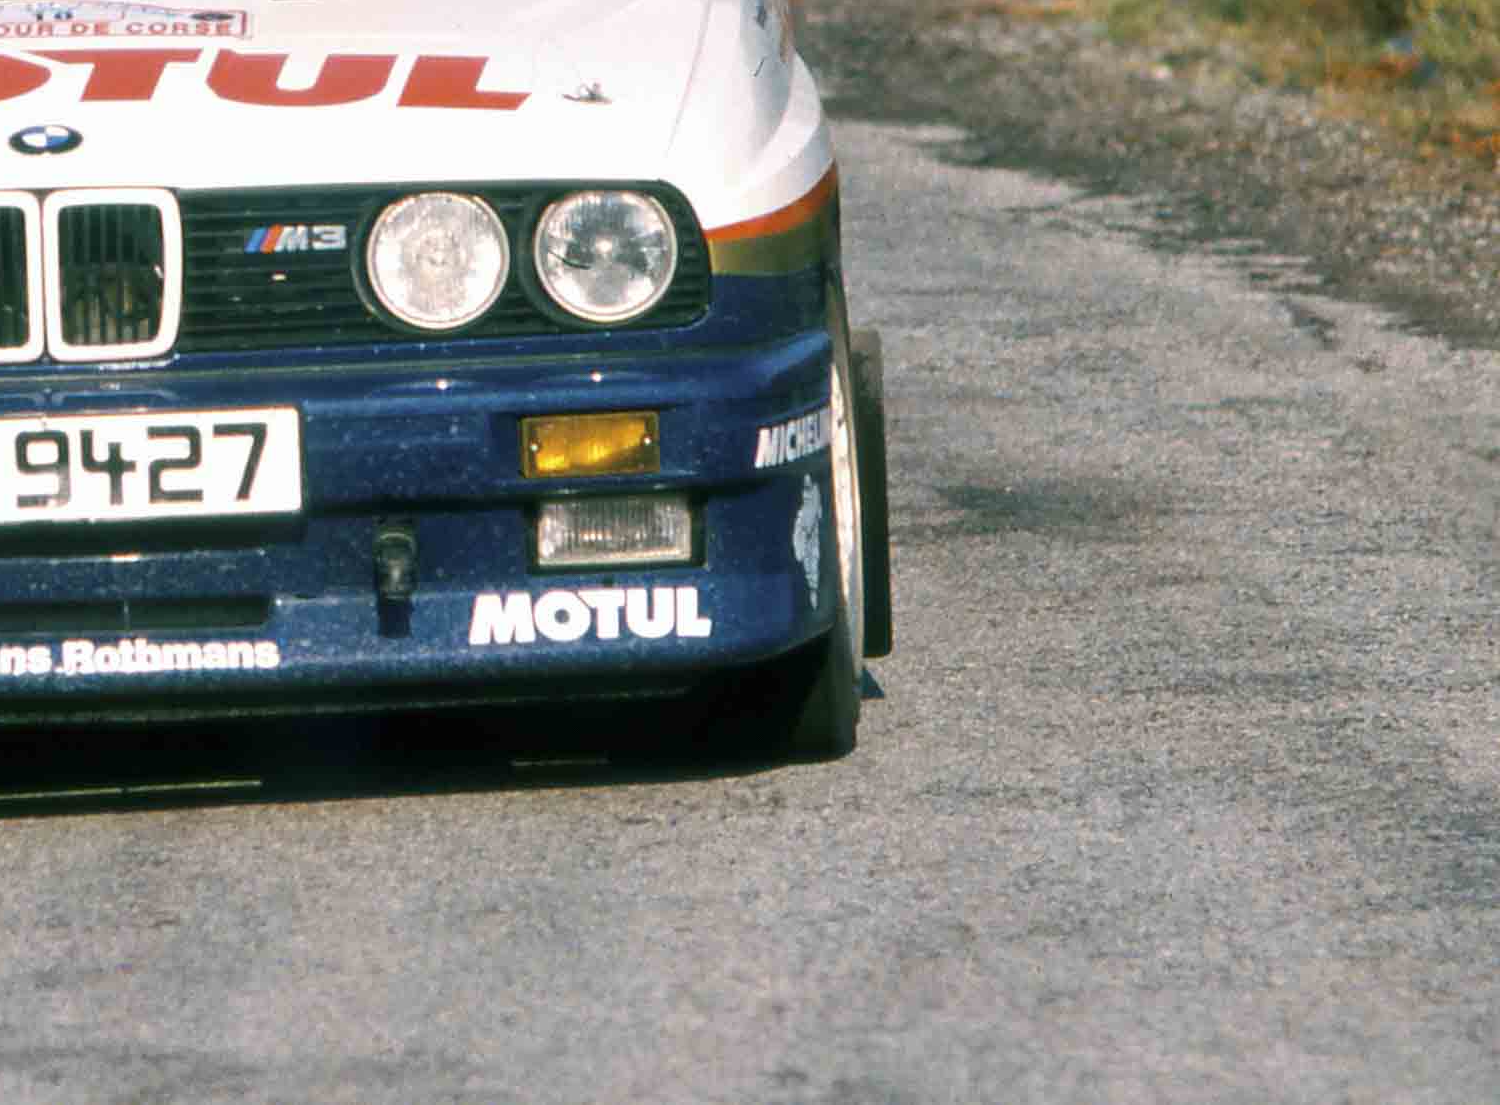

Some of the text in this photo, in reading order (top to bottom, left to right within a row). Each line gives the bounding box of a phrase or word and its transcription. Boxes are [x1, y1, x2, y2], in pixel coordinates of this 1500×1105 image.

[69, 21, 111, 37] DE
[125, 20, 232, 36] CORSE
[14, 422, 268, 509] 9427
[470, 587, 712, 645] MOTUL
[57, 638, 280, 675] Rothmans
